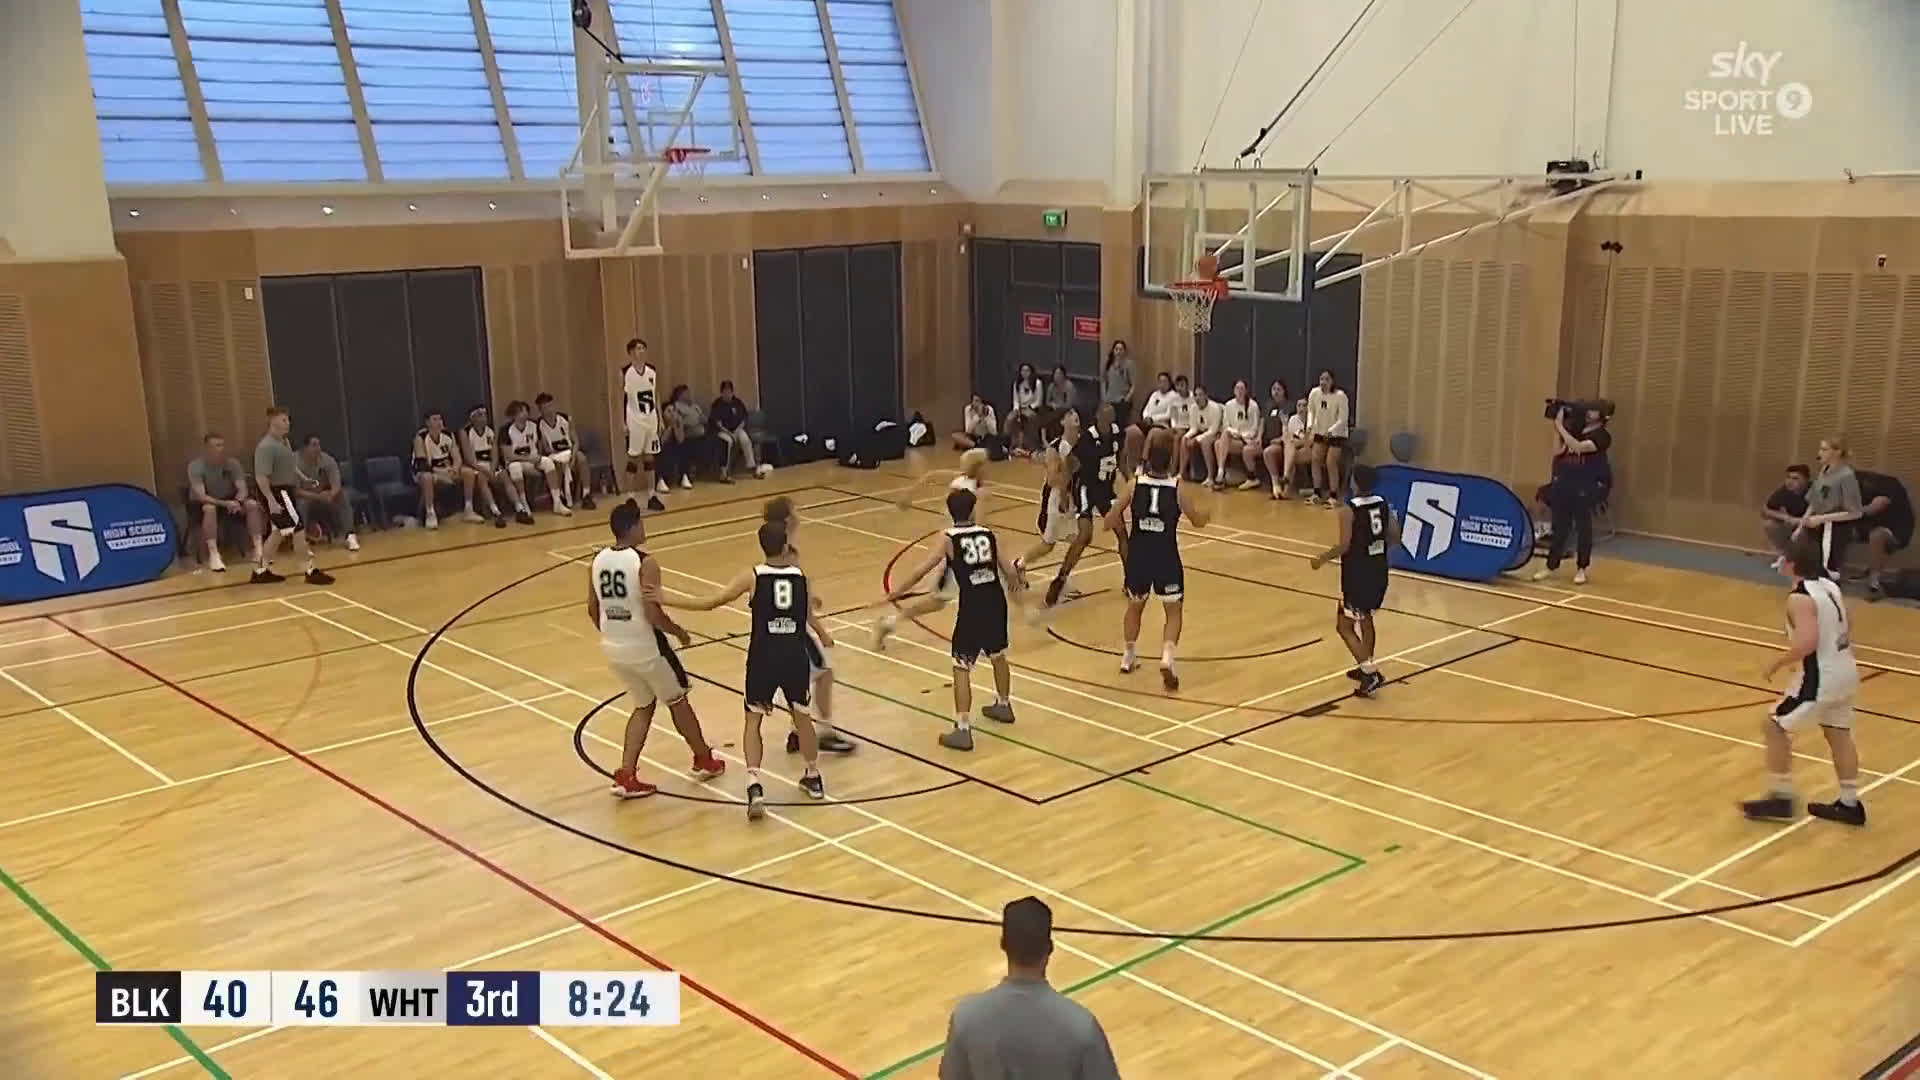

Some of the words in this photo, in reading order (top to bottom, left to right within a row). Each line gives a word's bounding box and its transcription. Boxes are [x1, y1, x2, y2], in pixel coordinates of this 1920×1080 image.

[1149, 487, 1160, 515] 1
[128, 523, 165, 537] SCHOOL
[1368, 508, 1383, 536] 5
[1481, 522, 1513, 538] SCHOOL
[960, 535, 992, 565] 32
[600, 570, 627, 599] 26
[773, 578, 793, 610] 8
